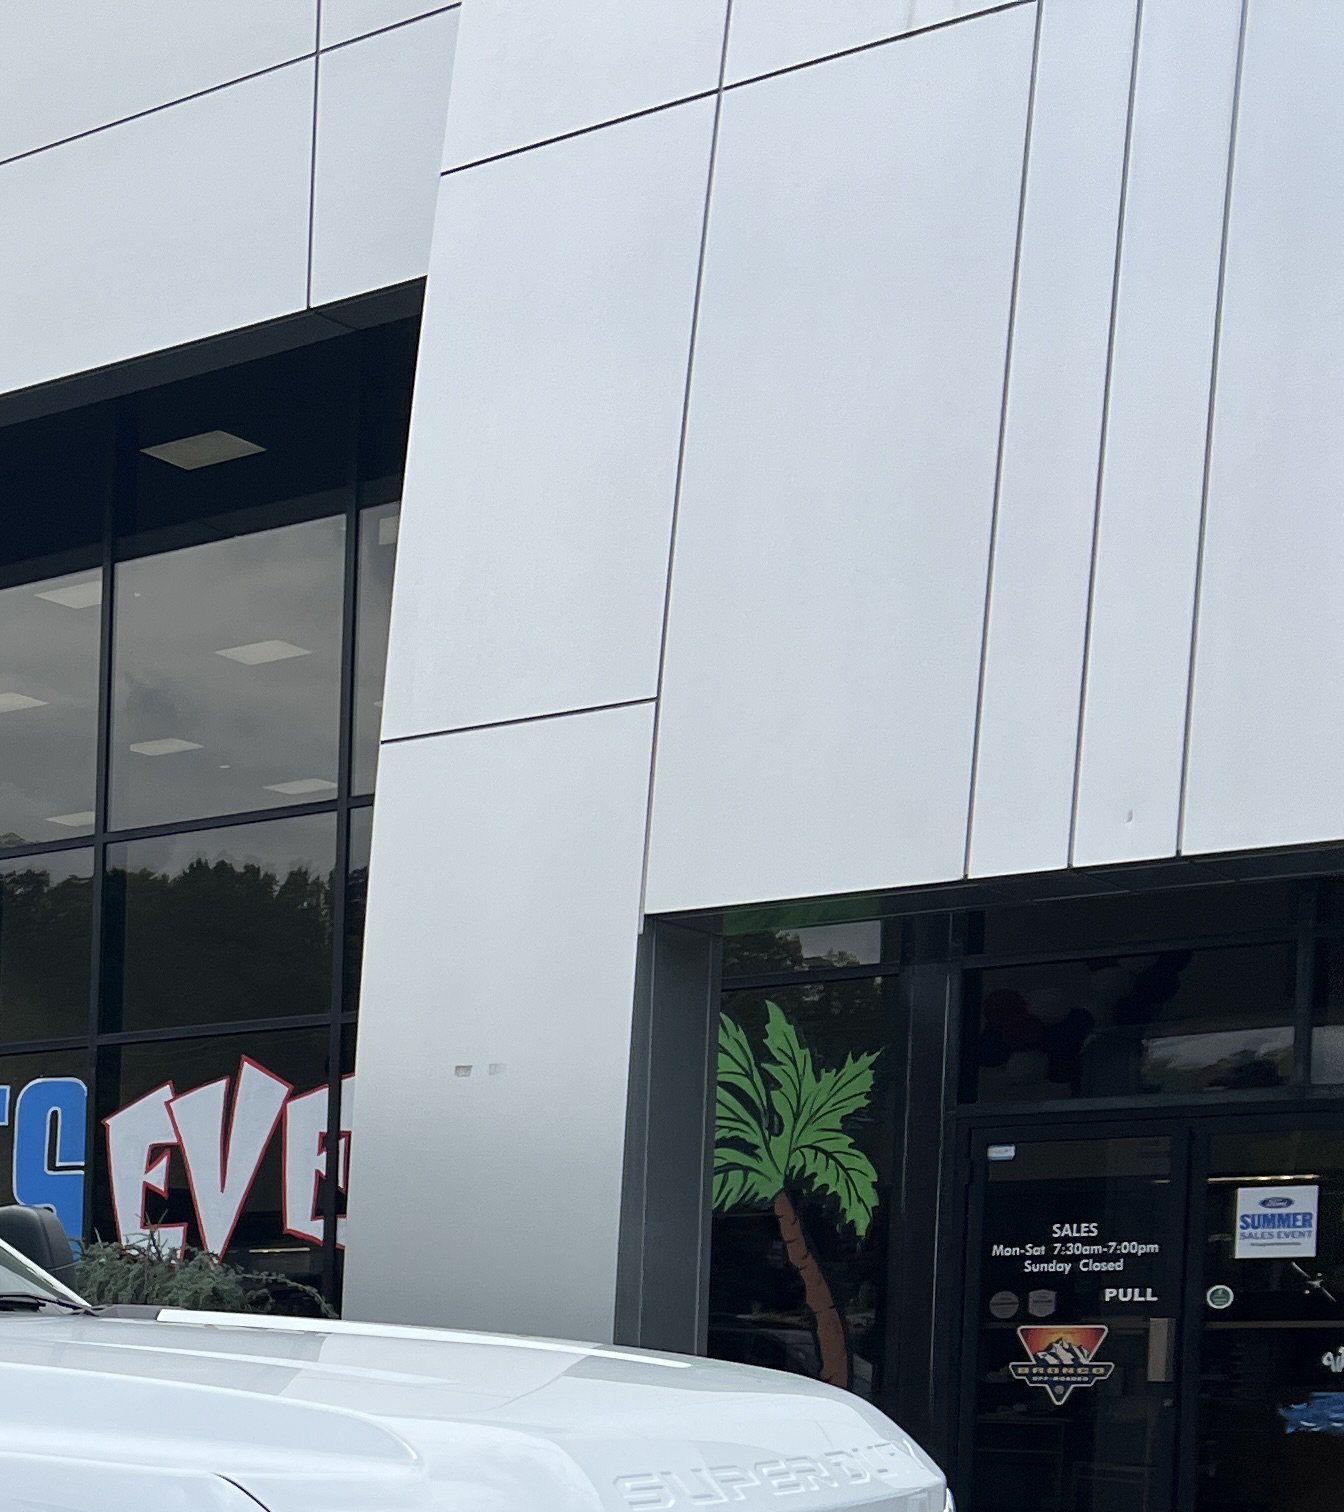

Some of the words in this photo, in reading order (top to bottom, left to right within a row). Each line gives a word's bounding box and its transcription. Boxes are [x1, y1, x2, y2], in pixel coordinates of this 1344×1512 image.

[1240, 1212, 1313, 1231] SUMMER
[1052, 1223, 1098, 1238] SALES
[1240, 1231, 1274, 1241] SALES
[1277, 1230, 1313, 1240] EVENT
[991, 1244, 1046, 1257] Mon-Sat
[1052, 1242, 1160, 1257] 7:30am-7:00pm
[1023, 1260, 1072, 1275] Sunday
[1079, 1258, 1124, 1272] Closed
[1104, 1288, 1159, 1302] PULL
[1017, 1366, 1106, 1375] BRONCO
